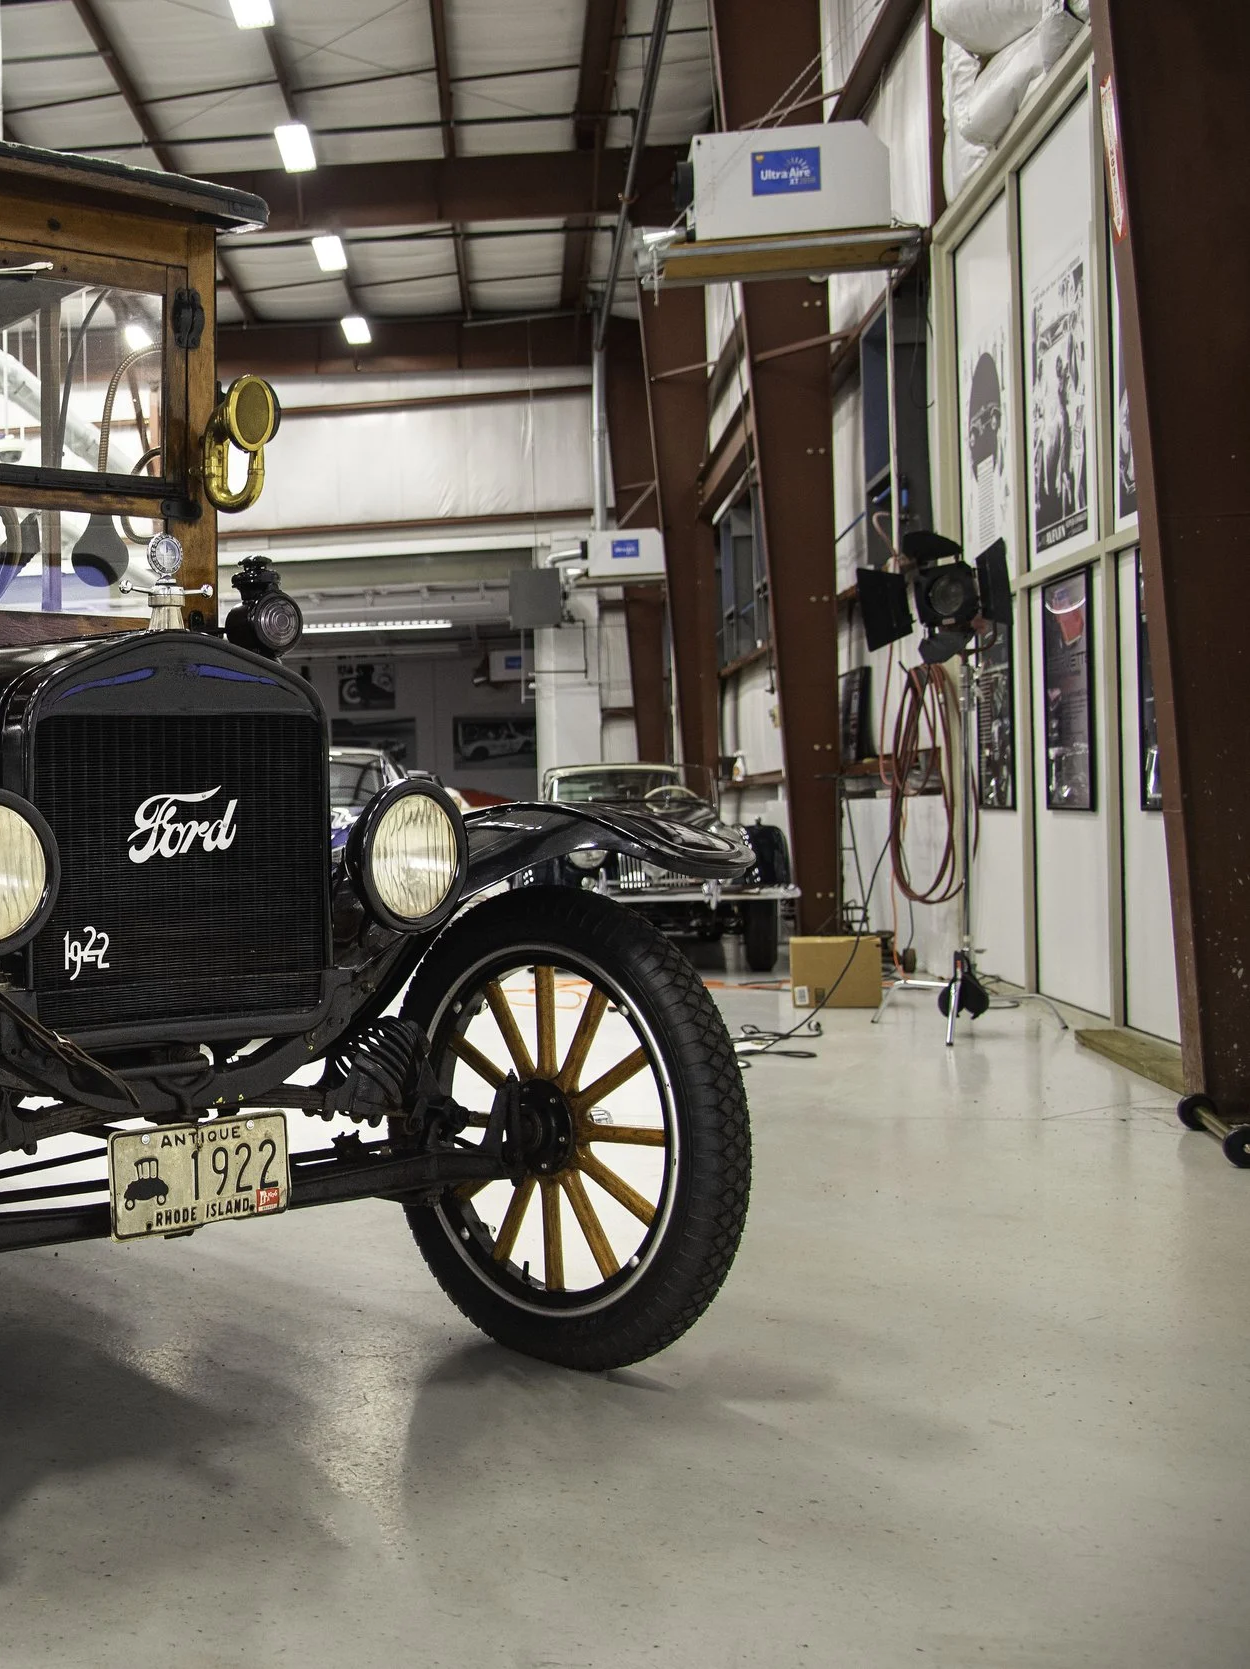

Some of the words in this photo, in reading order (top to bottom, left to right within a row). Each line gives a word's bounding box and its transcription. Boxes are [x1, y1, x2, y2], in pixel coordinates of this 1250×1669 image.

[127, 785, 238, 864] Ford
[63, 925, 110, 981] 1922
[160, 1125, 242, 1149] ANTIQUE
[191, 1138, 279, 1201] 1922
[155, 1206, 197, 1228] RHODE
[206, 1198, 250, 1219] ISLAND
